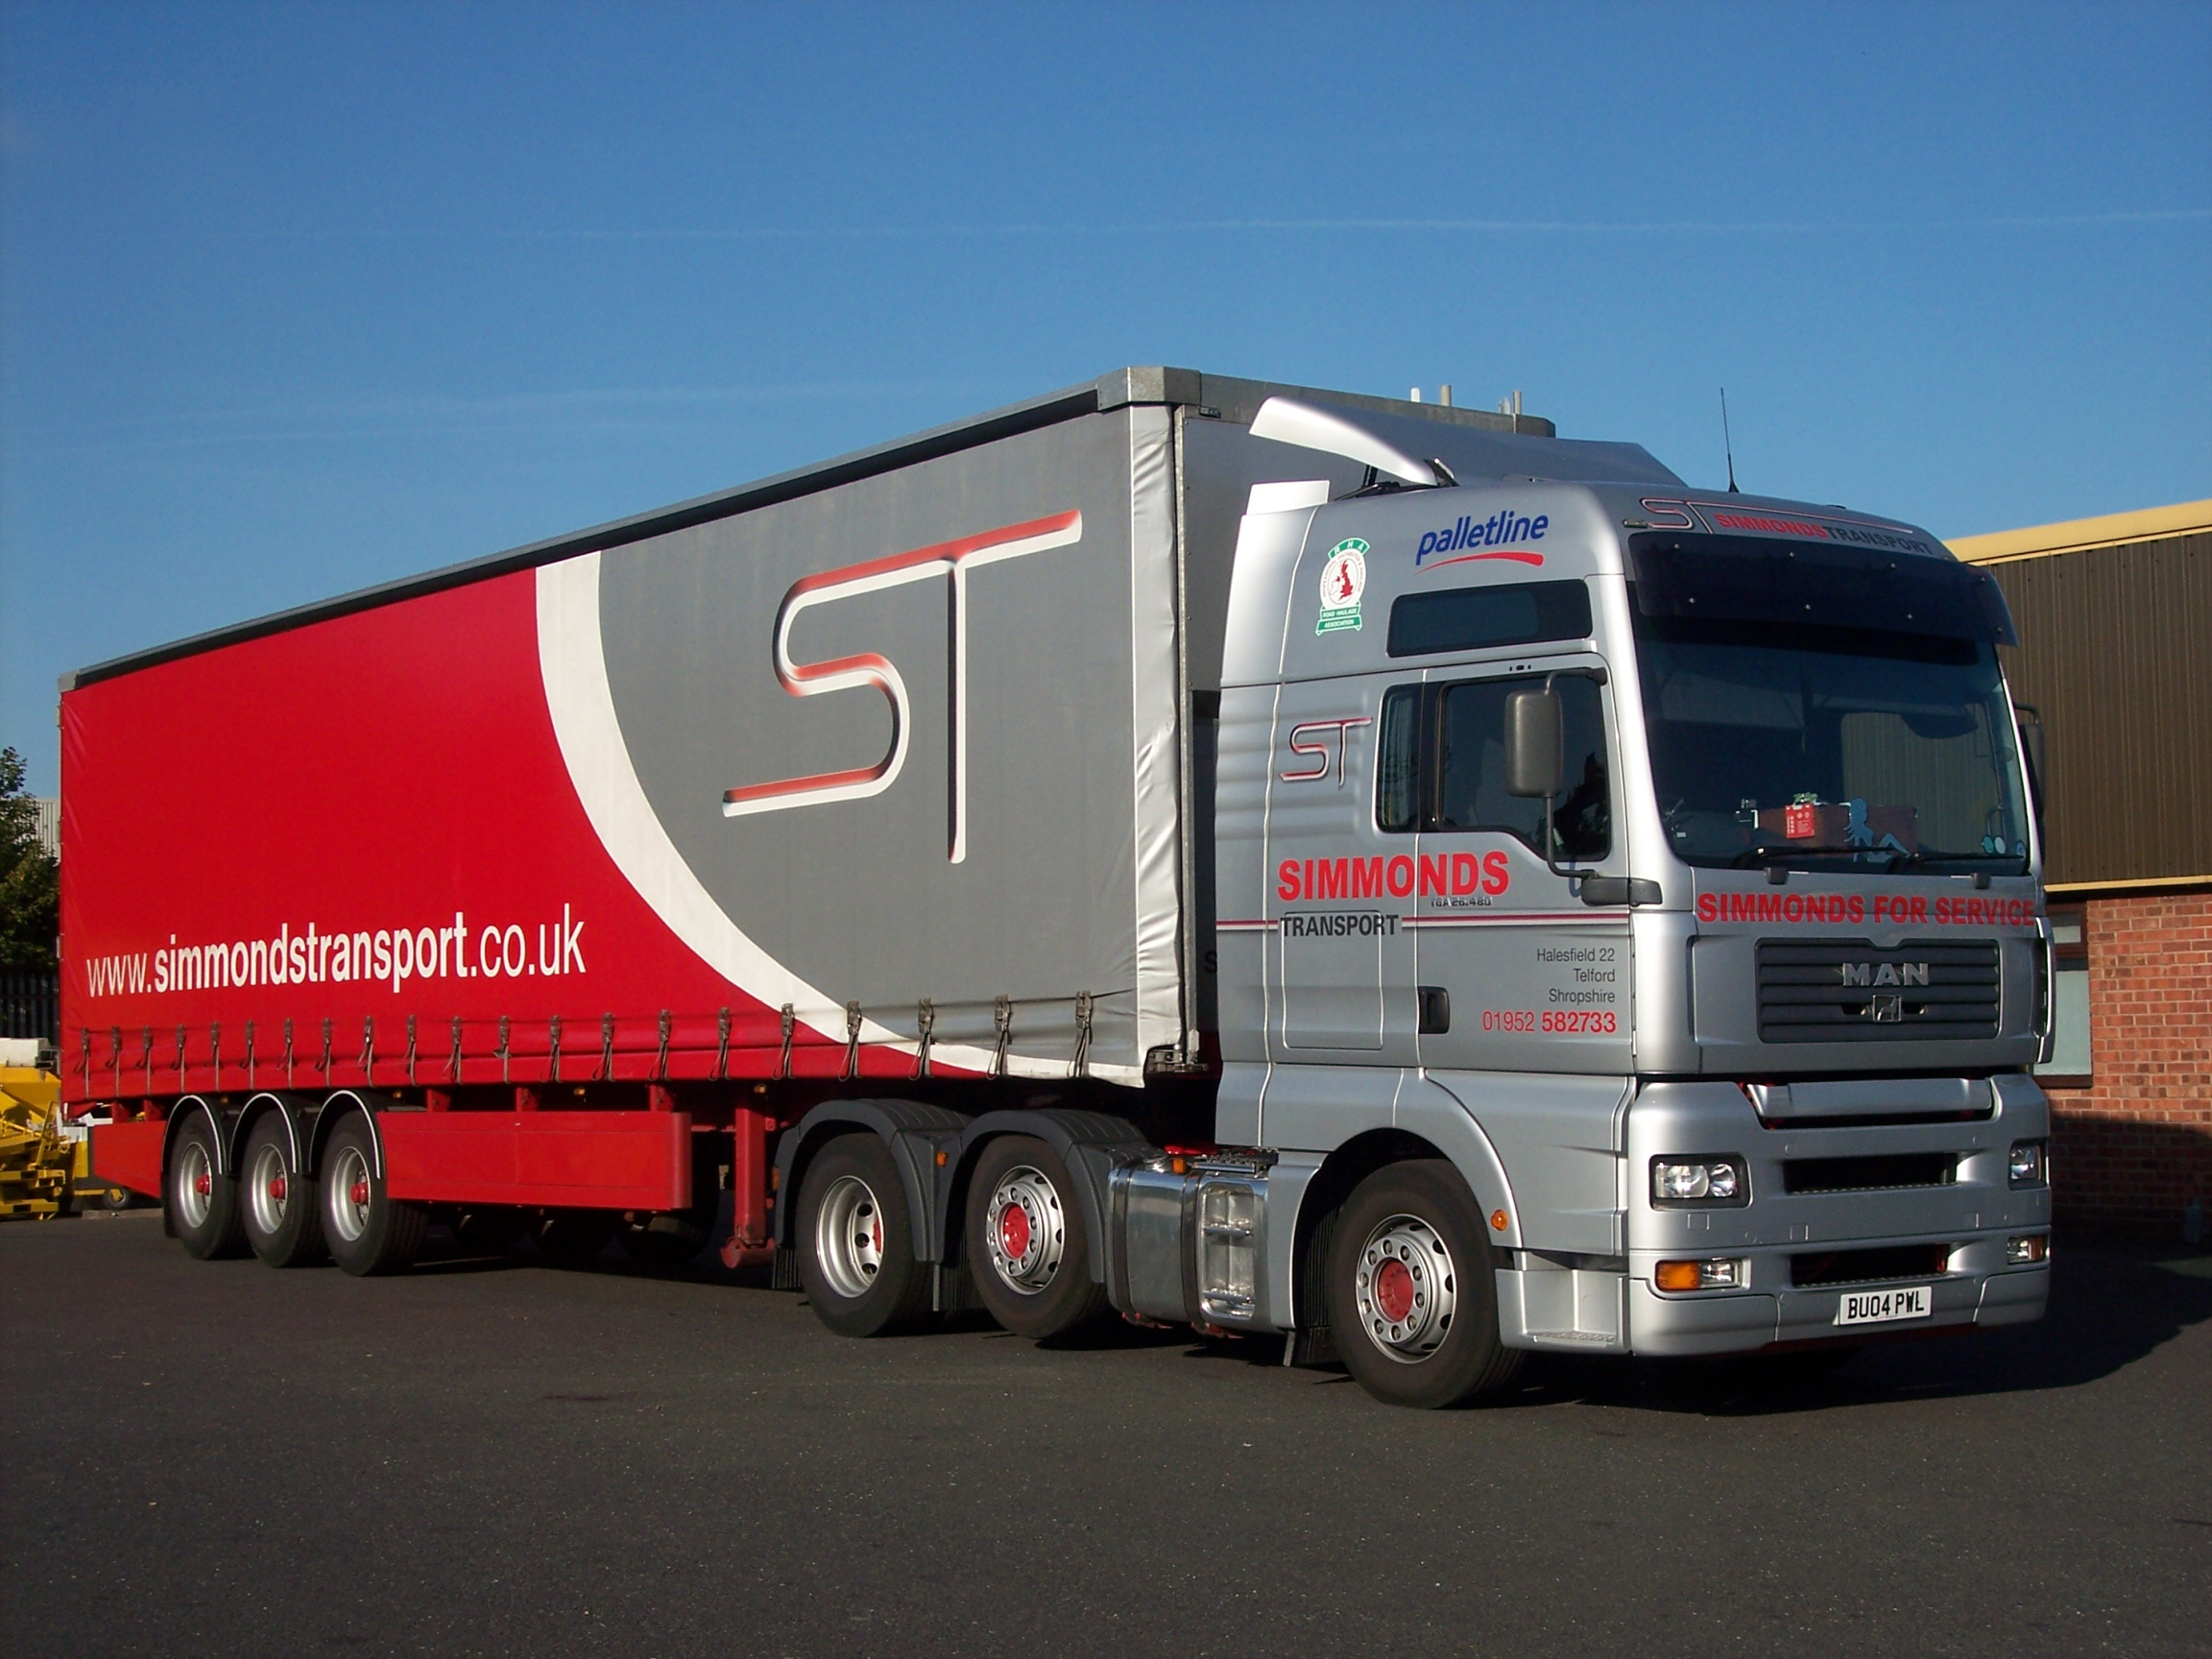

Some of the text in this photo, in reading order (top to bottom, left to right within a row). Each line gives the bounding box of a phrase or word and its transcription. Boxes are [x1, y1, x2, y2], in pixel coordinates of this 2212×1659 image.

[1415, 510, 1550, 565] palletline
[722, 508, 1083, 864] ST
[1278, 716, 1373, 788] ST
[1277, 850, 1510, 901] SIMMONDS
[1696, 892, 2035, 926] SIMMONDS FOR SERVICE
[1280, 914, 1399, 937] TRANSPORT
[87, 902, 586, 998] www.simmondstransport.co.uk
[1536, 948, 1615, 962] Halesfield 22
[1574, 968, 1616, 983] Telford
[1842, 963, 1929, 987] MAN
[1549, 988, 1616, 1006] Shropshire
[1482, 1011, 1617, 1034] 01952 582733
[1848, 1290, 1925, 1319] BU04 PWL
